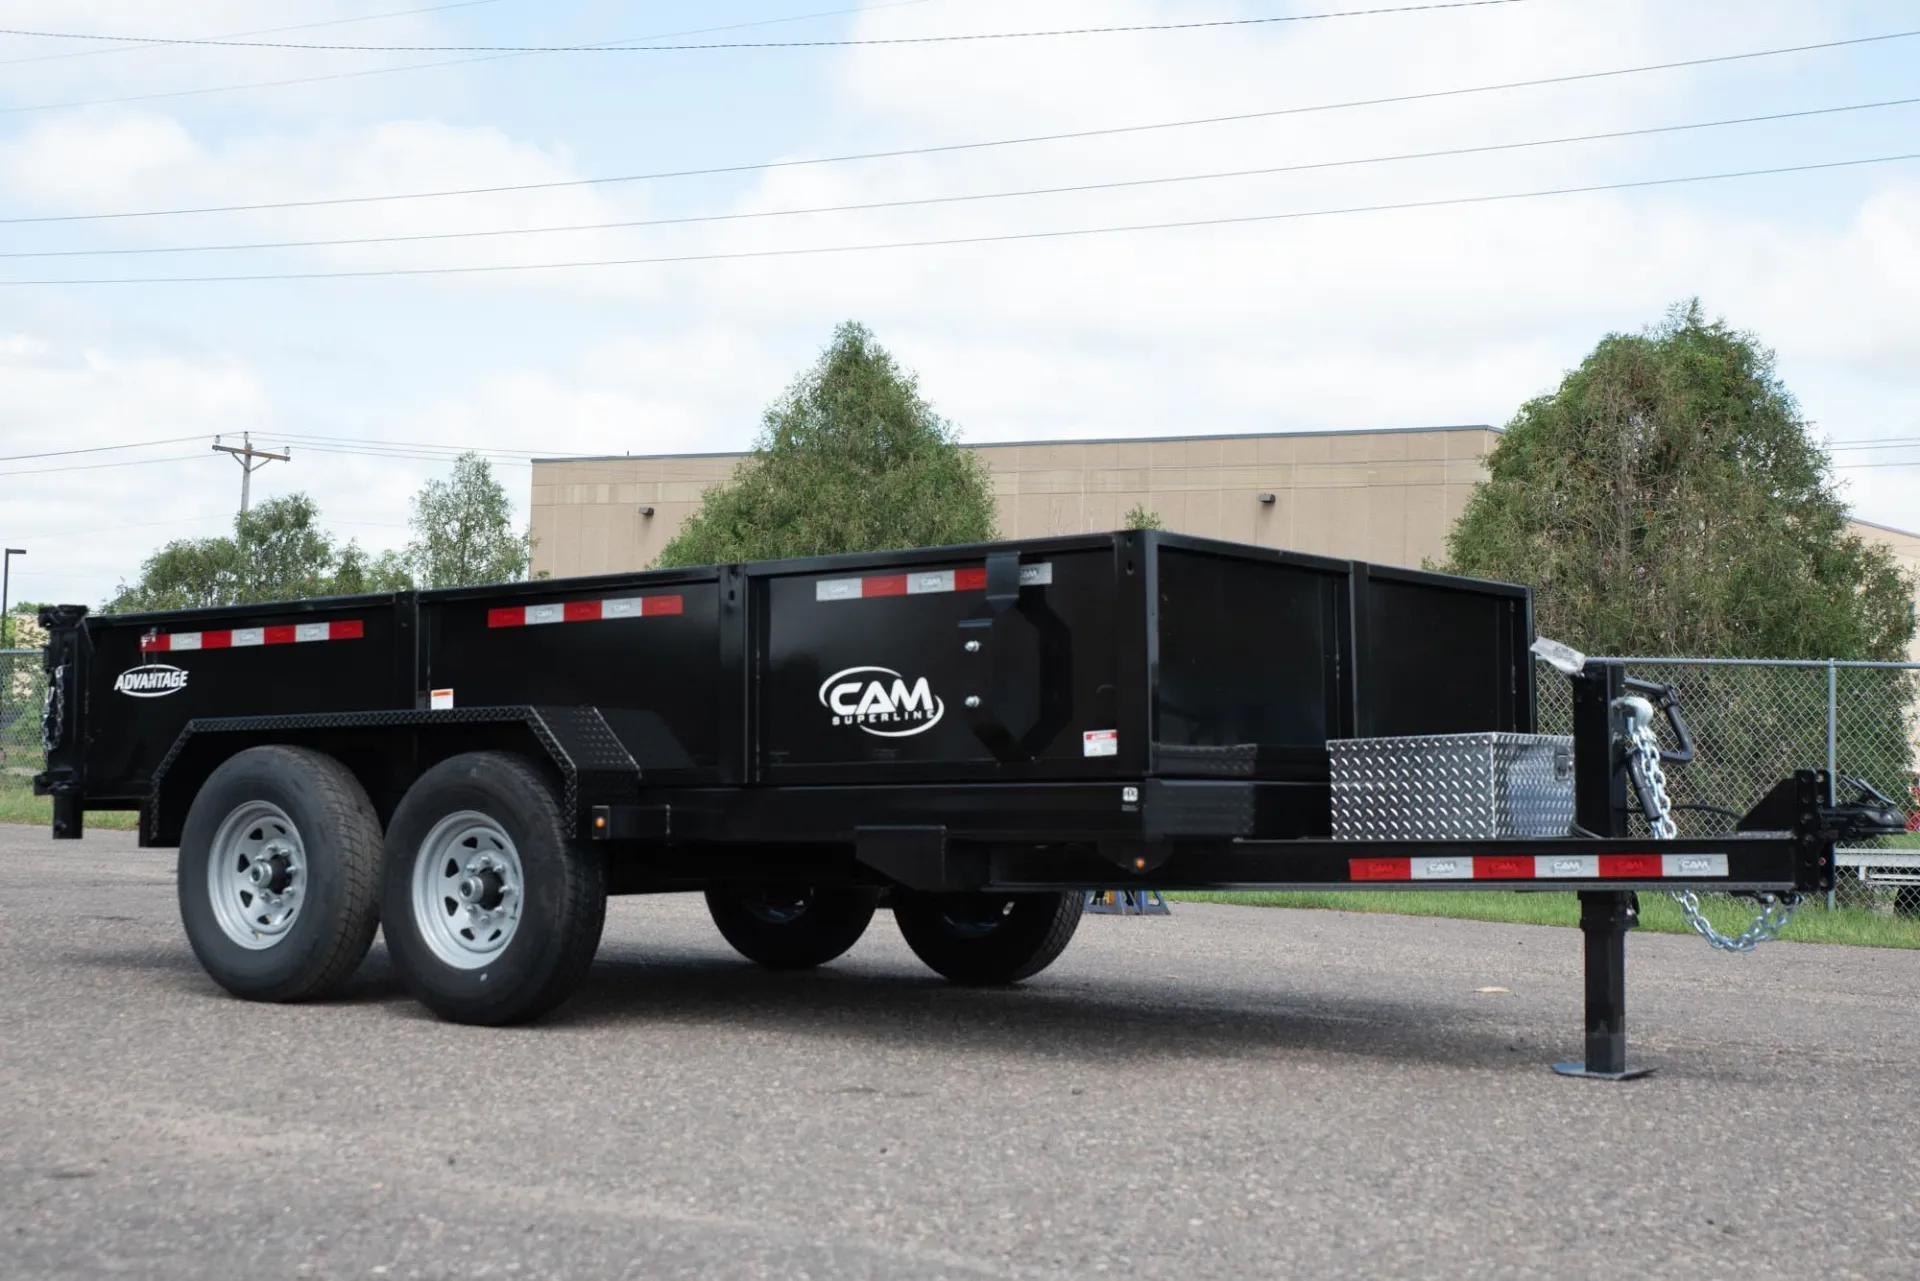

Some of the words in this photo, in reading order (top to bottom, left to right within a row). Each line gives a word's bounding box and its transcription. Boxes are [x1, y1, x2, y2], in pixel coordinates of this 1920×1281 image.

[114, 671, 188, 690] ADVANTAGE
[830, 677, 934, 715] CAM
[832, 710, 935, 726] SUPERLINE
[1429, 862, 1455, 872] CAM
[1554, 861, 1580, 871] CAM
[1681, 860, 1709, 870] CAM
